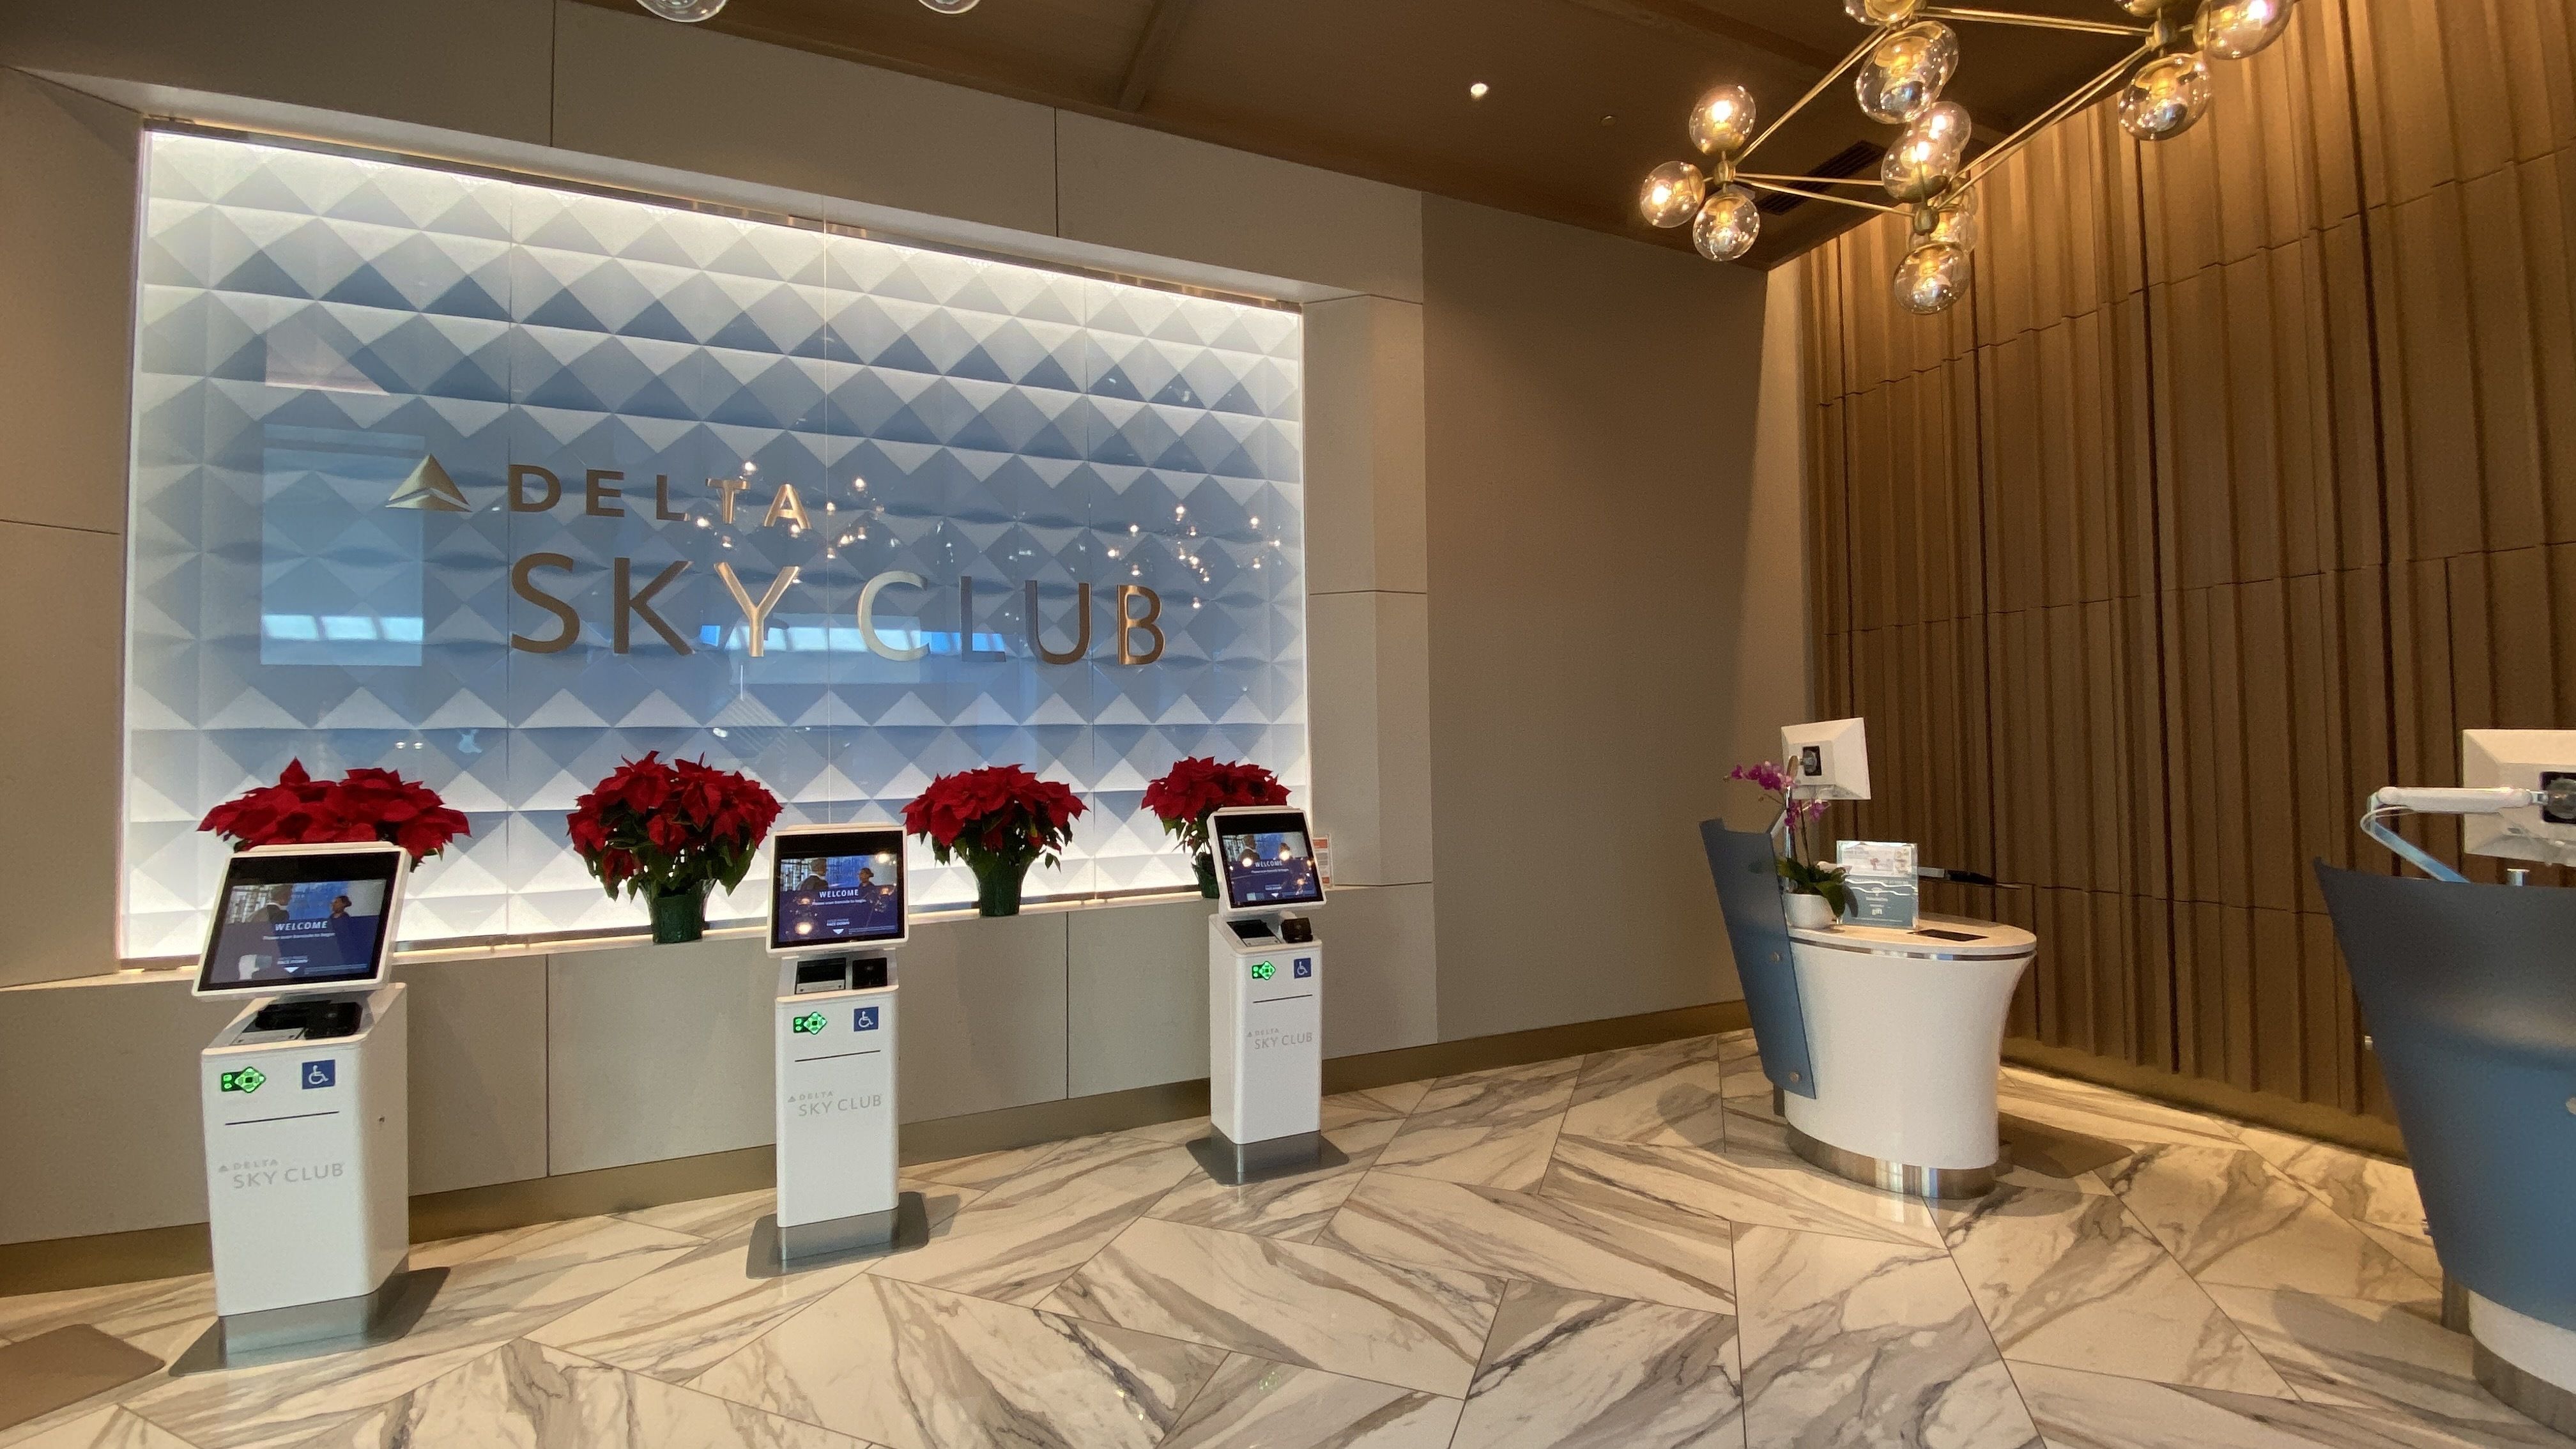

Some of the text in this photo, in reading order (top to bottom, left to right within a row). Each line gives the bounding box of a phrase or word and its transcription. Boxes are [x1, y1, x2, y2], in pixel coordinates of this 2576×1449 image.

[509, 464, 812, 530] DELTA
[510, 552, 1166, 666] SKY CLUB
[819, 889, 859, 898] WELCOME
[275, 921, 328, 931] WELCOME
[1254, 1031, 1313, 1050] SKY CLUB
[799, 1091, 833, 1101] DELTA
[799, 1094, 882, 1117] SKY CLUB
[233, 1158, 278, 1170] DELTA
[233, 1162, 343, 1189] SKY CLUB
